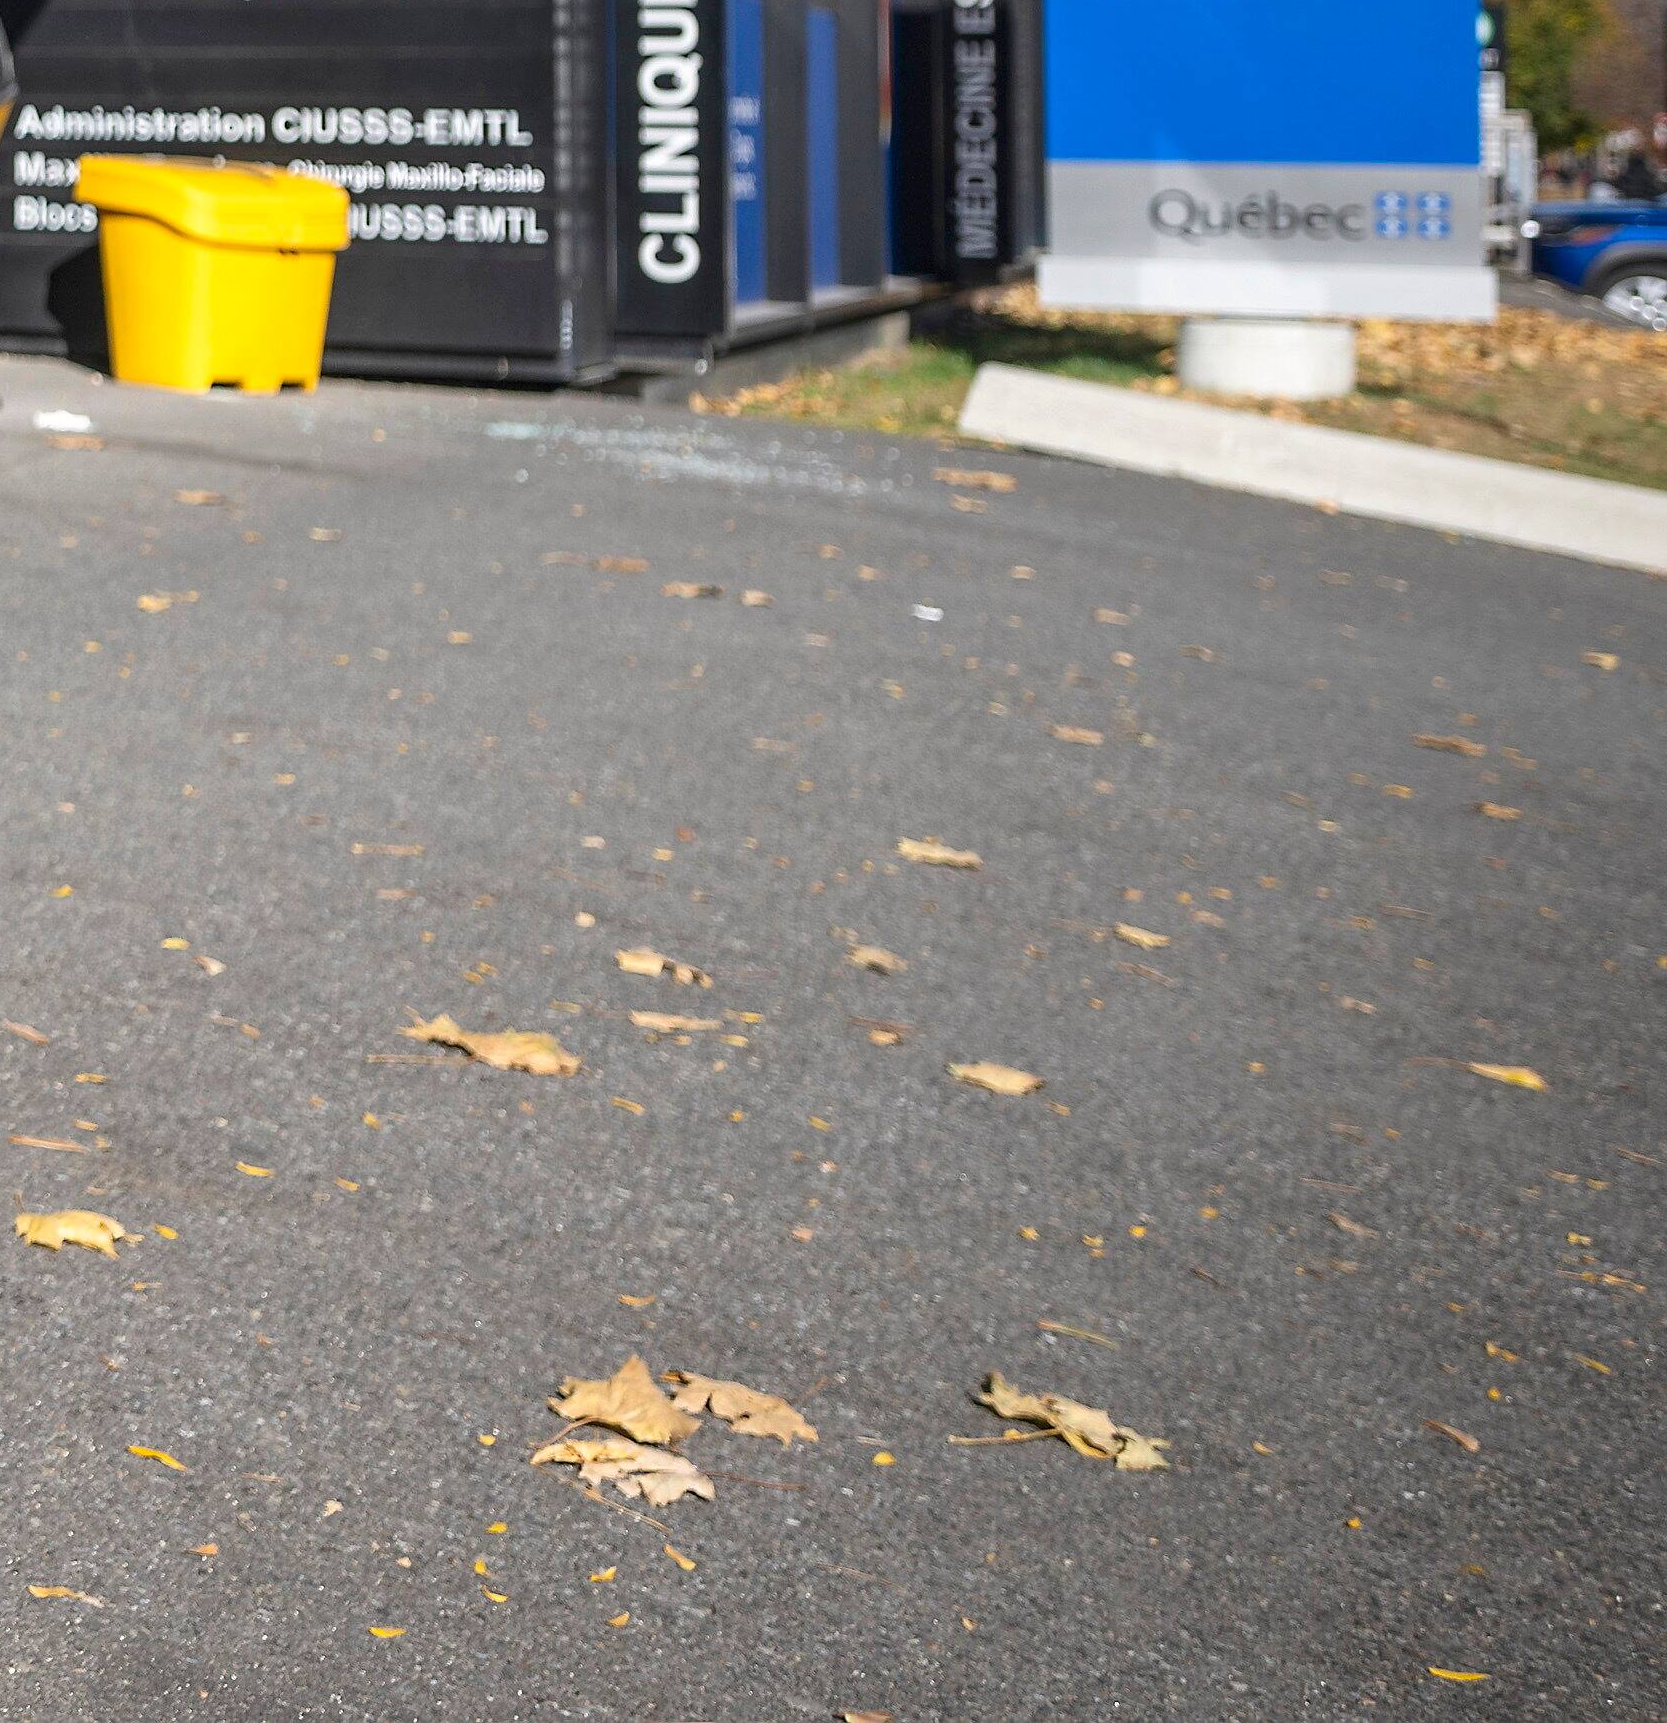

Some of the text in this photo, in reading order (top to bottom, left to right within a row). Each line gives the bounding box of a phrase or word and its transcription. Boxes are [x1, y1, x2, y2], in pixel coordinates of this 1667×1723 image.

[14, 104, 533, 147] Administration CIUSSS-EMTL
[954, 38, 997, 259] MÉDECINE
[13, 196, 548, 244] Blocs IUSSS-EMTL
[1148, 187, 1364, 244] Québec
